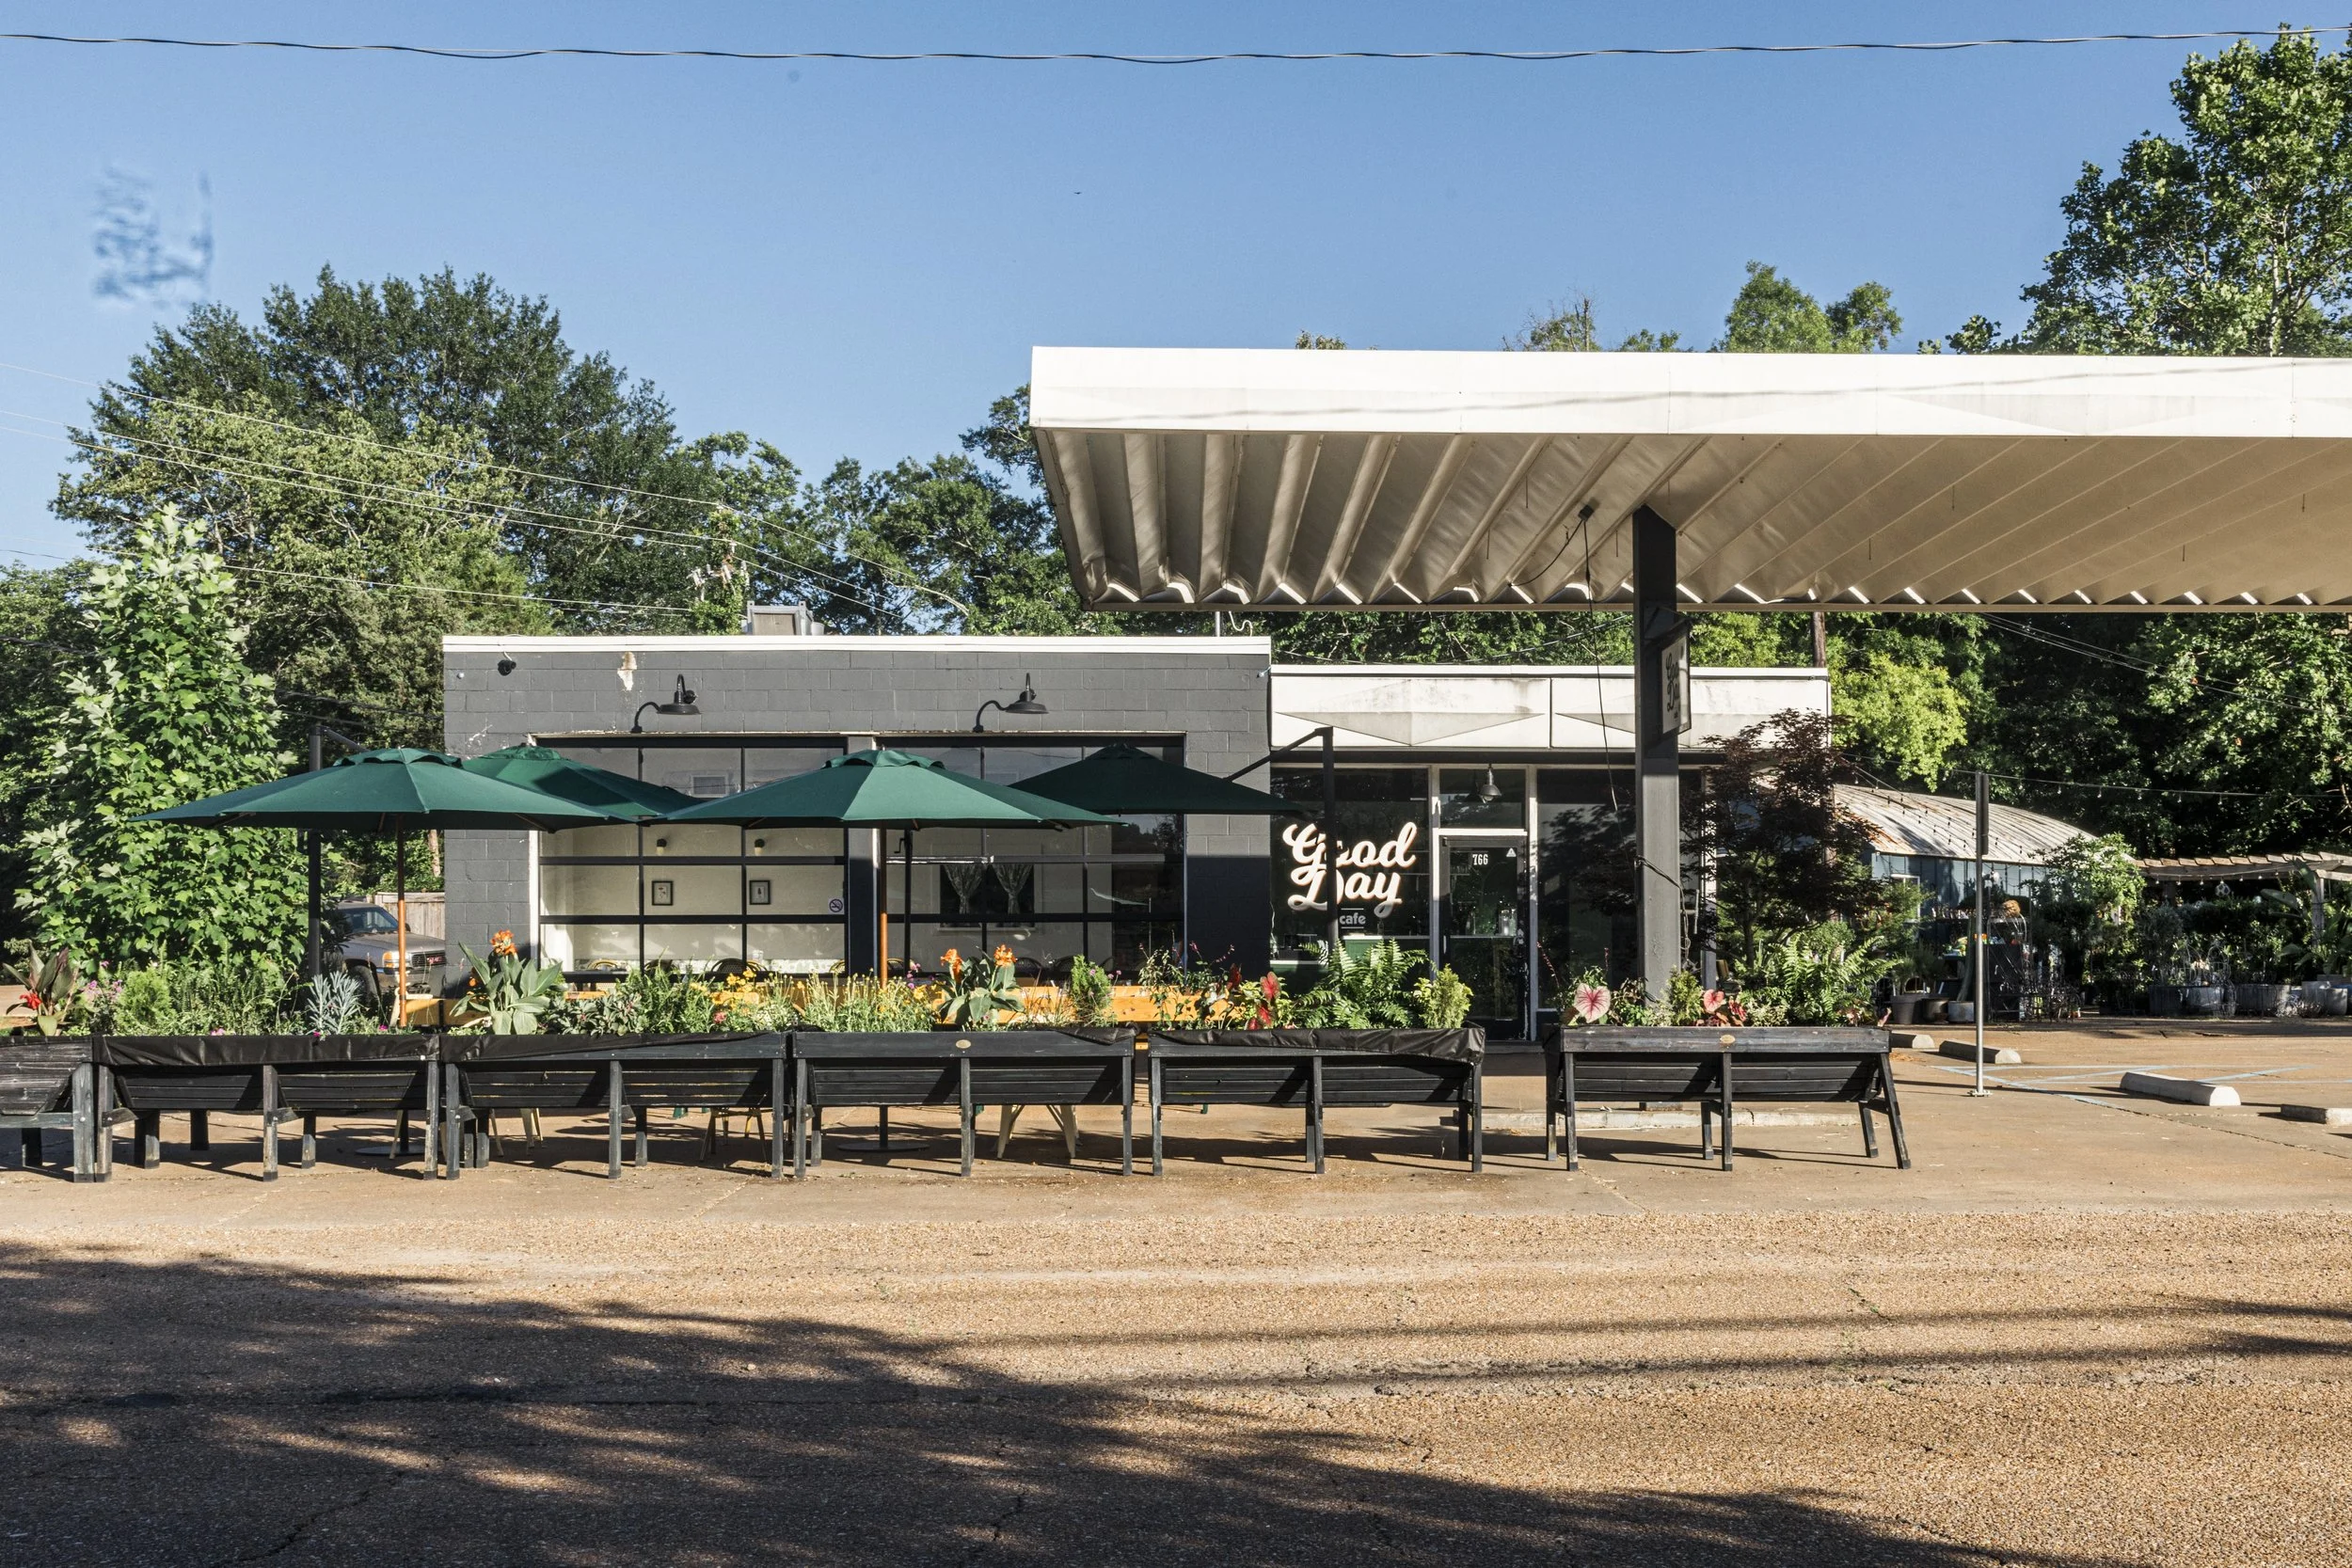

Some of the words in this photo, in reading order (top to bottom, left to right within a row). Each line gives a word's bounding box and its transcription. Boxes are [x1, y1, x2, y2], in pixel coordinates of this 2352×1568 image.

[1472, 853, 1488, 865] 766
[1287, 869, 1403, 918] Day
[1339, 911, 1367, 925] cafe
